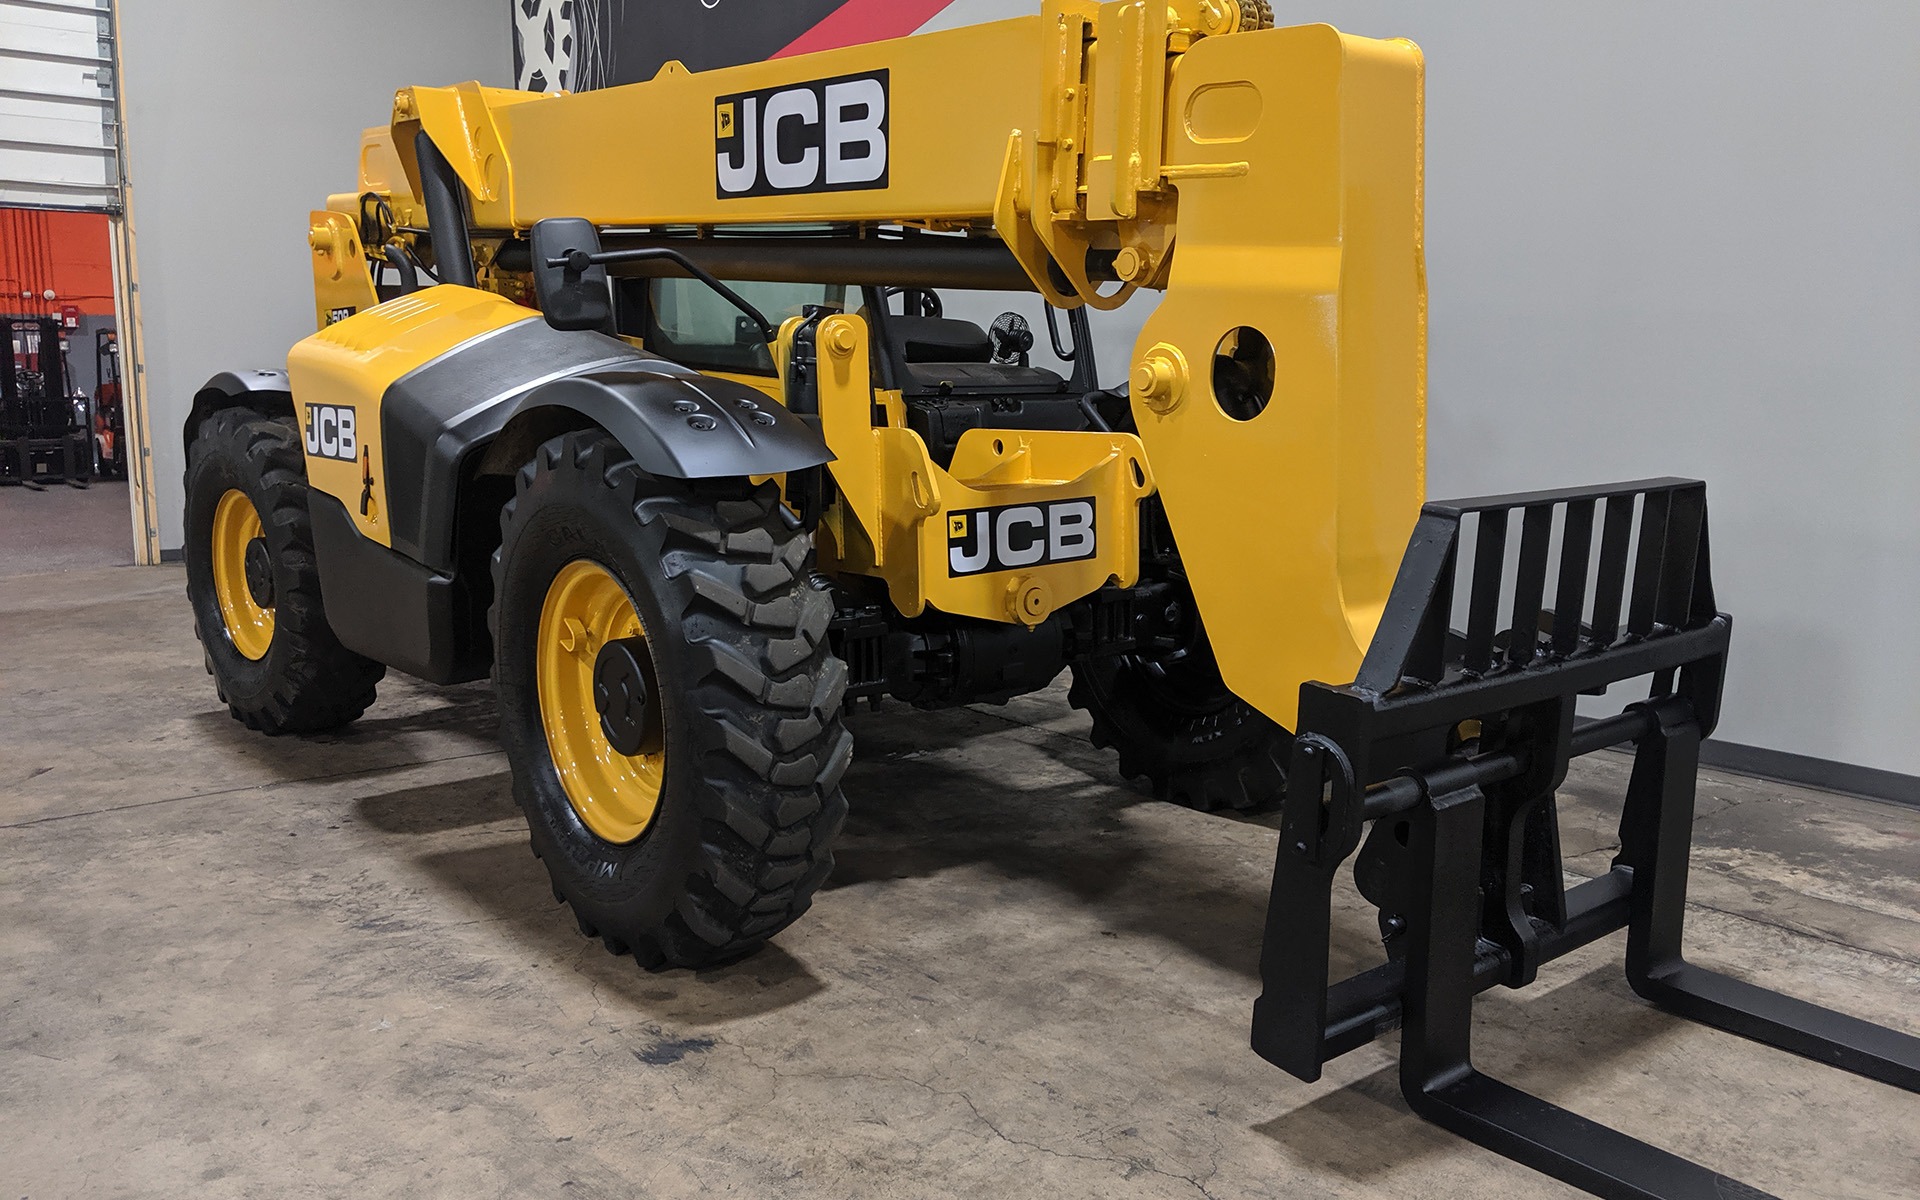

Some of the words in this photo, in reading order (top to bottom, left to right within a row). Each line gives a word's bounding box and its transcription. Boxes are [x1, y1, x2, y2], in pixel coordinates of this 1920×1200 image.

[717, 78, 887, 193] JCB
[306, 406, 356, 459] JCB
[949, 501, 1095, 573] JCB
